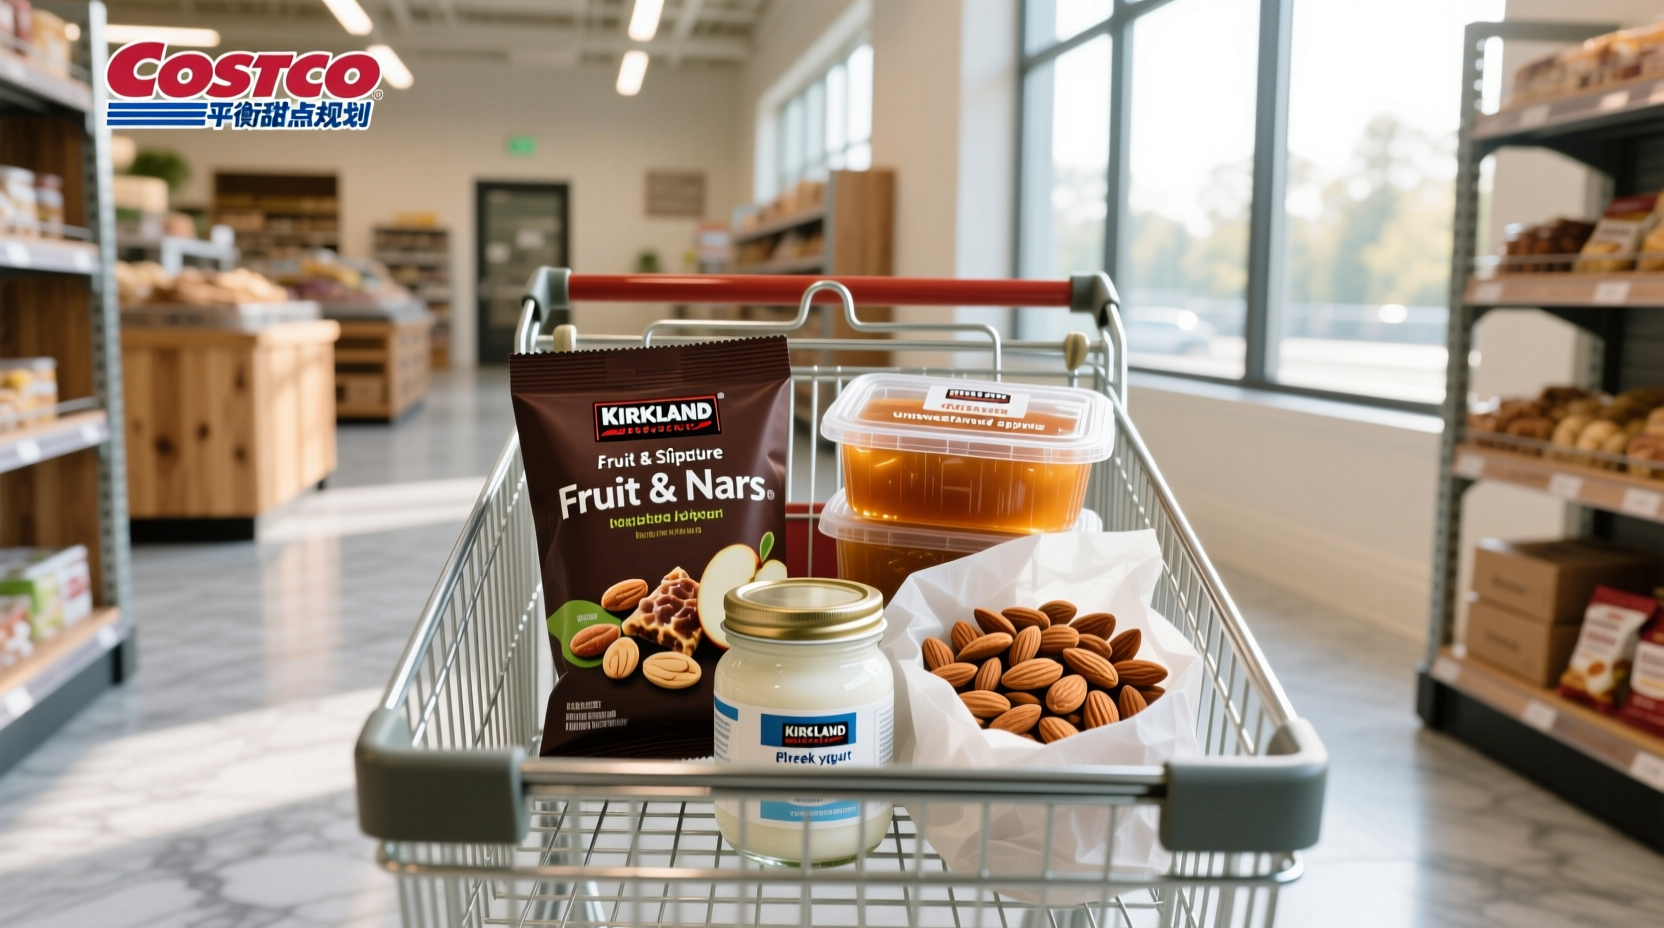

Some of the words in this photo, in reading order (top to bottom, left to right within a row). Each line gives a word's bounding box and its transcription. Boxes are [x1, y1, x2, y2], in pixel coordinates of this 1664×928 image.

[601, 402, 712, 425] KIRKLAND
[597, 453, 636, 469] Fruit
[640, 451, 652, 465] &
[558, 476, 641, 520] Fruit
[649, 472, 677, 504] &
[685, 469, 765, 501] Nars
